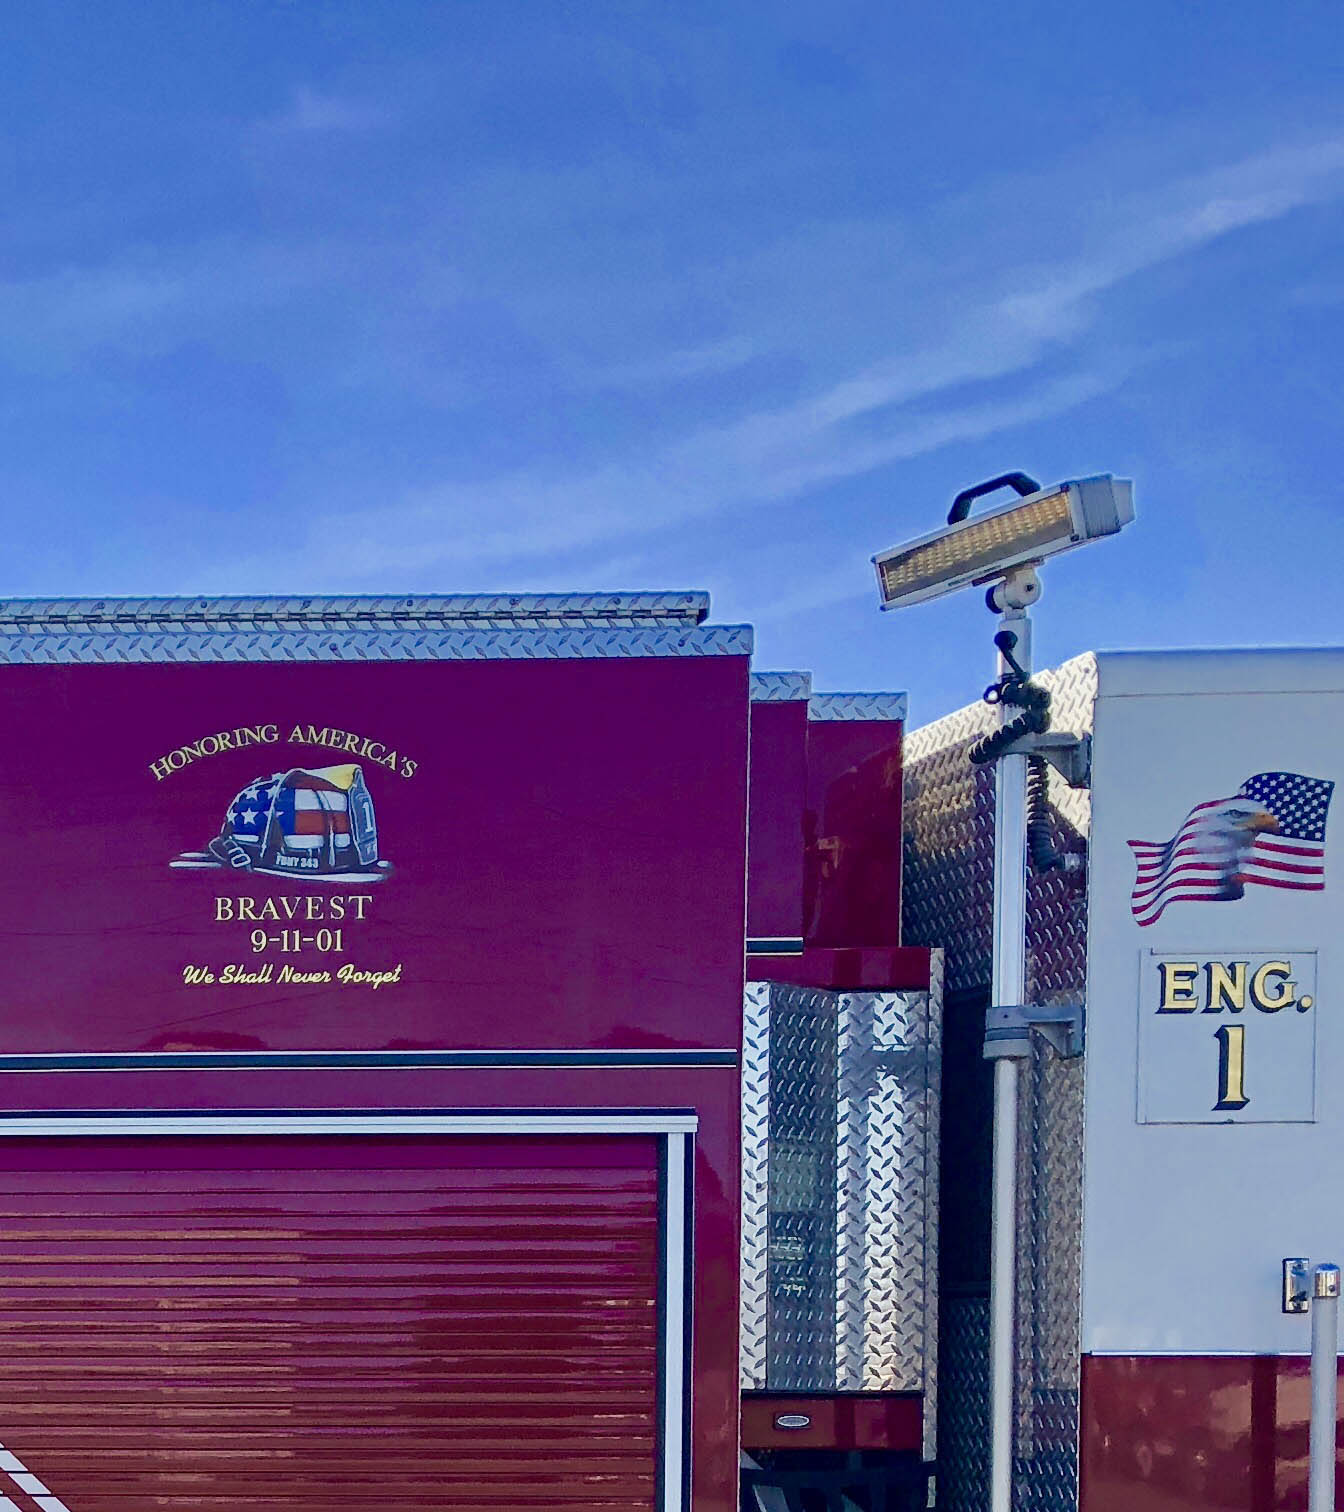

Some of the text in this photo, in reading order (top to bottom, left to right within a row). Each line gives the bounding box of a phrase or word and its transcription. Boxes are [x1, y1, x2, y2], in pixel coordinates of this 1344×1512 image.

[149, 724, 418, 782] HONORING AMERICA'S
[214, 895, 373, 921] BRAVEST
[250, 928, 344, 953] 9-11-01
[182, 963, 402, 990] We Shall Never Forget
[1155, 960, 1314, 1015] ENG.
[1211, 1023, 1251, 1112] 1
